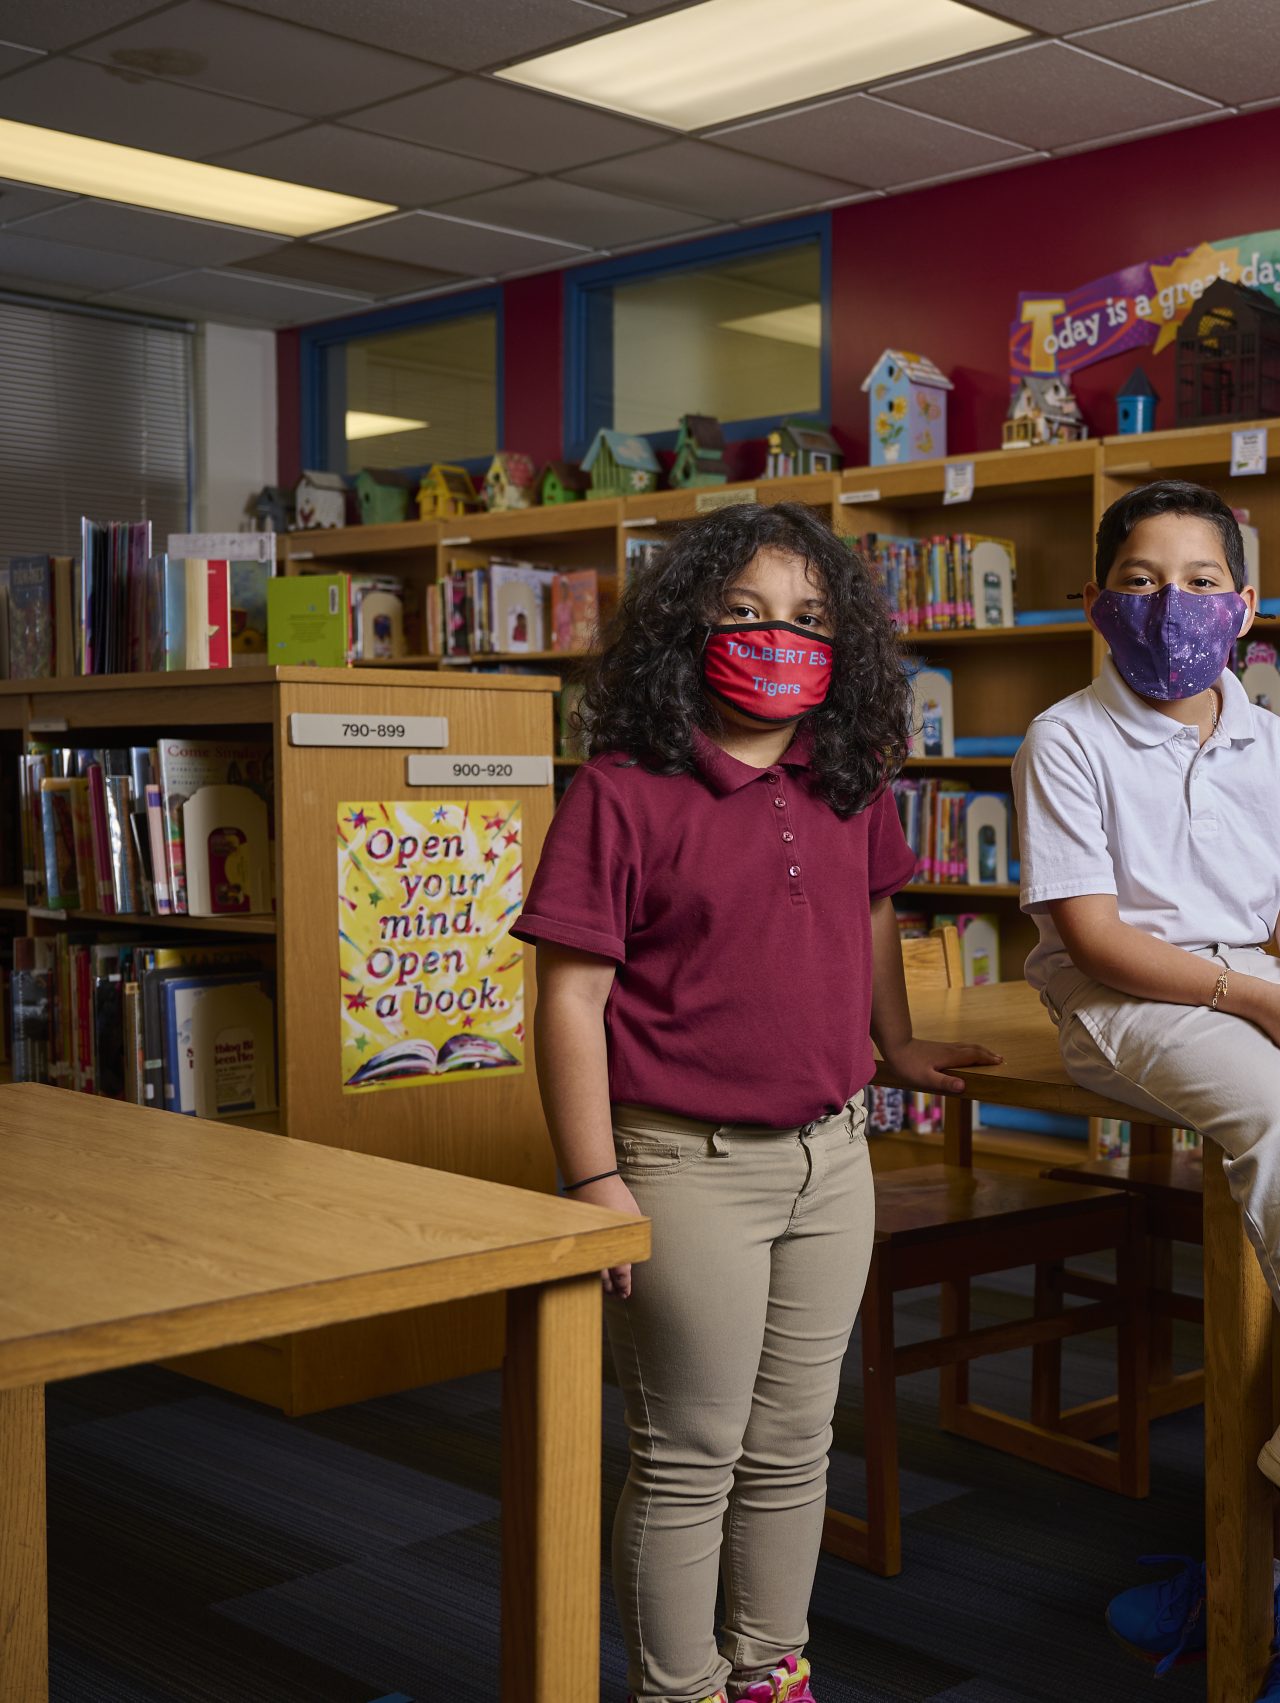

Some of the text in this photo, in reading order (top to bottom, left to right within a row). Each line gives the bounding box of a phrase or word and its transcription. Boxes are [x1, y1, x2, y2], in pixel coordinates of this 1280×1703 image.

[1020, 298, 1100, 374] Today
[1105, 297, 1128, 327] is
[1134, 294, 1152, 317] a
[727, 641, 827, 666] TOLBERT ES
[752, 676, 801, 697] Tigers
[341, 723, 406, 738] 790-899
[452, 764, 513, 777] 900-920
[365, 828, 465, 869] Open
[400, 872, 485, 909] your
[379, 902, 482, 940] mind.
[366, 946, 465, 987] Open
[375, 977, 506, 1019] a book.
